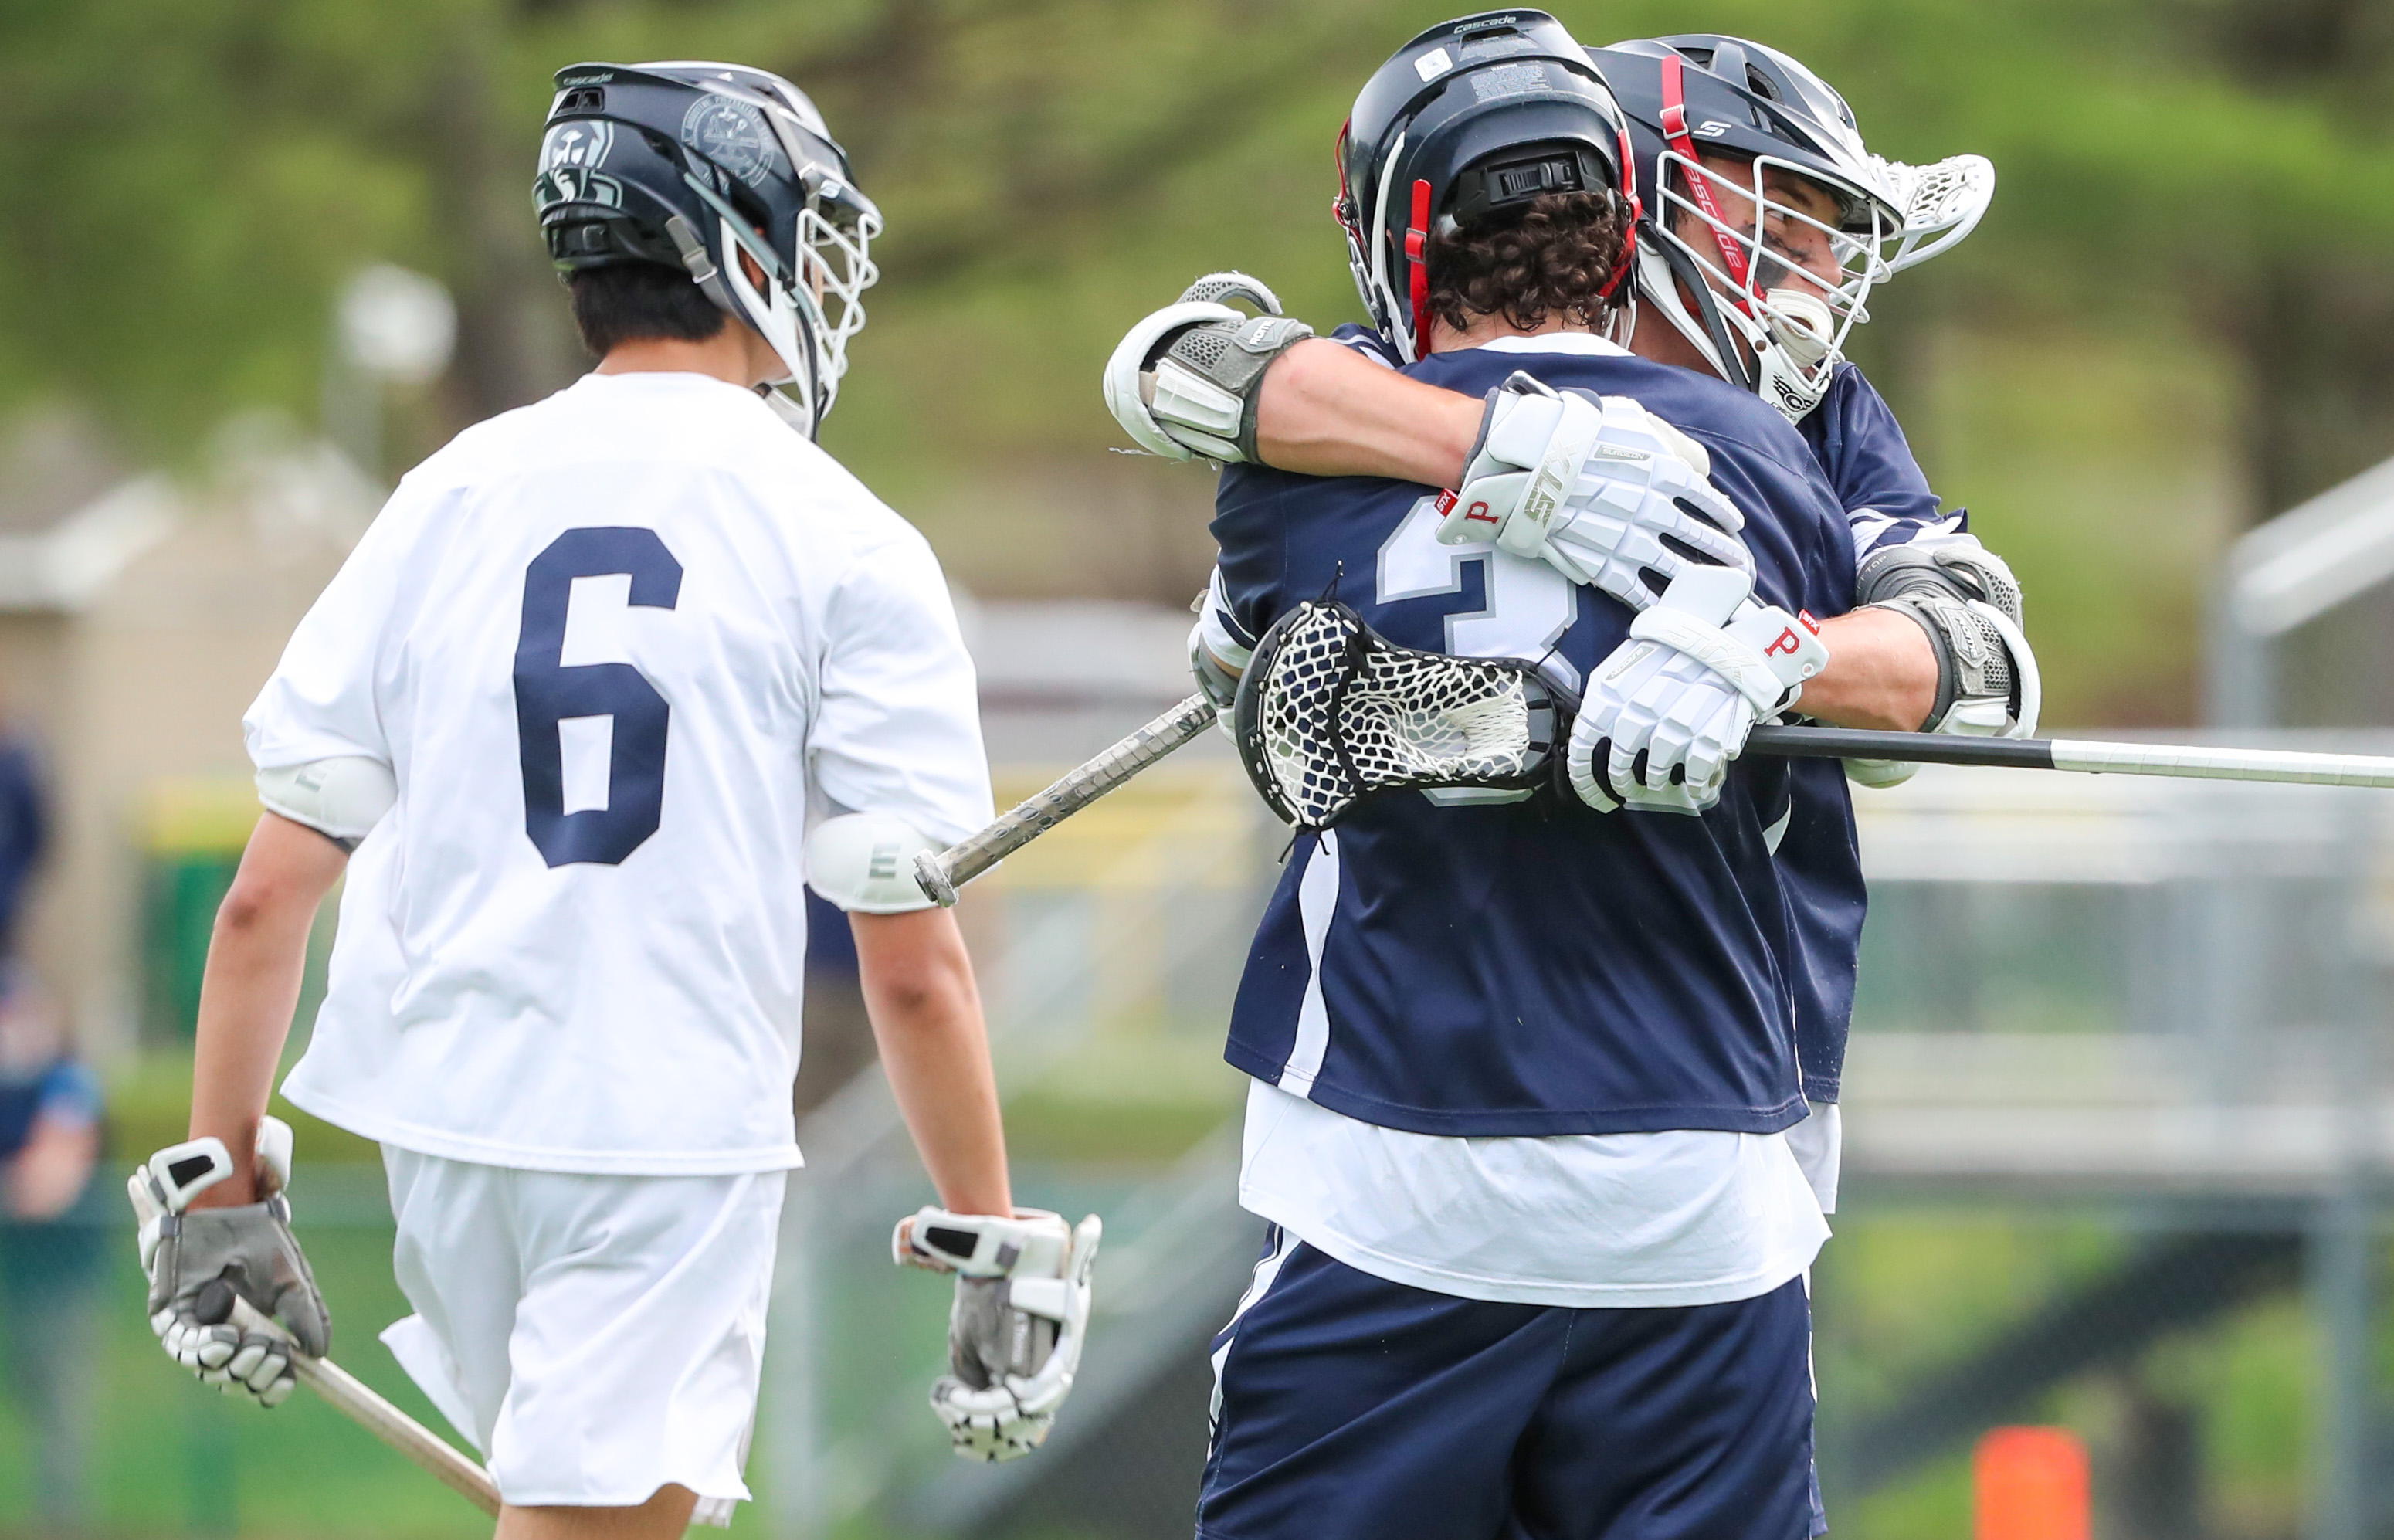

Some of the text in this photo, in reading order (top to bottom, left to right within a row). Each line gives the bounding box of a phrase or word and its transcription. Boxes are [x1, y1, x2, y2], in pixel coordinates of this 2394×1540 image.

[1453, 15, 1517, 35] cascade
[1678, 148, 1743, 269] cascde
[1522, 428, 1582, 530] STX
[1436, 492, 1452, 512] STX
[1464, 500, 1500, 525] P
[1803, 612, 1820, 631] STX
[1763, 625, 1801, 658] P
[514, 526, 683, 870] 6
